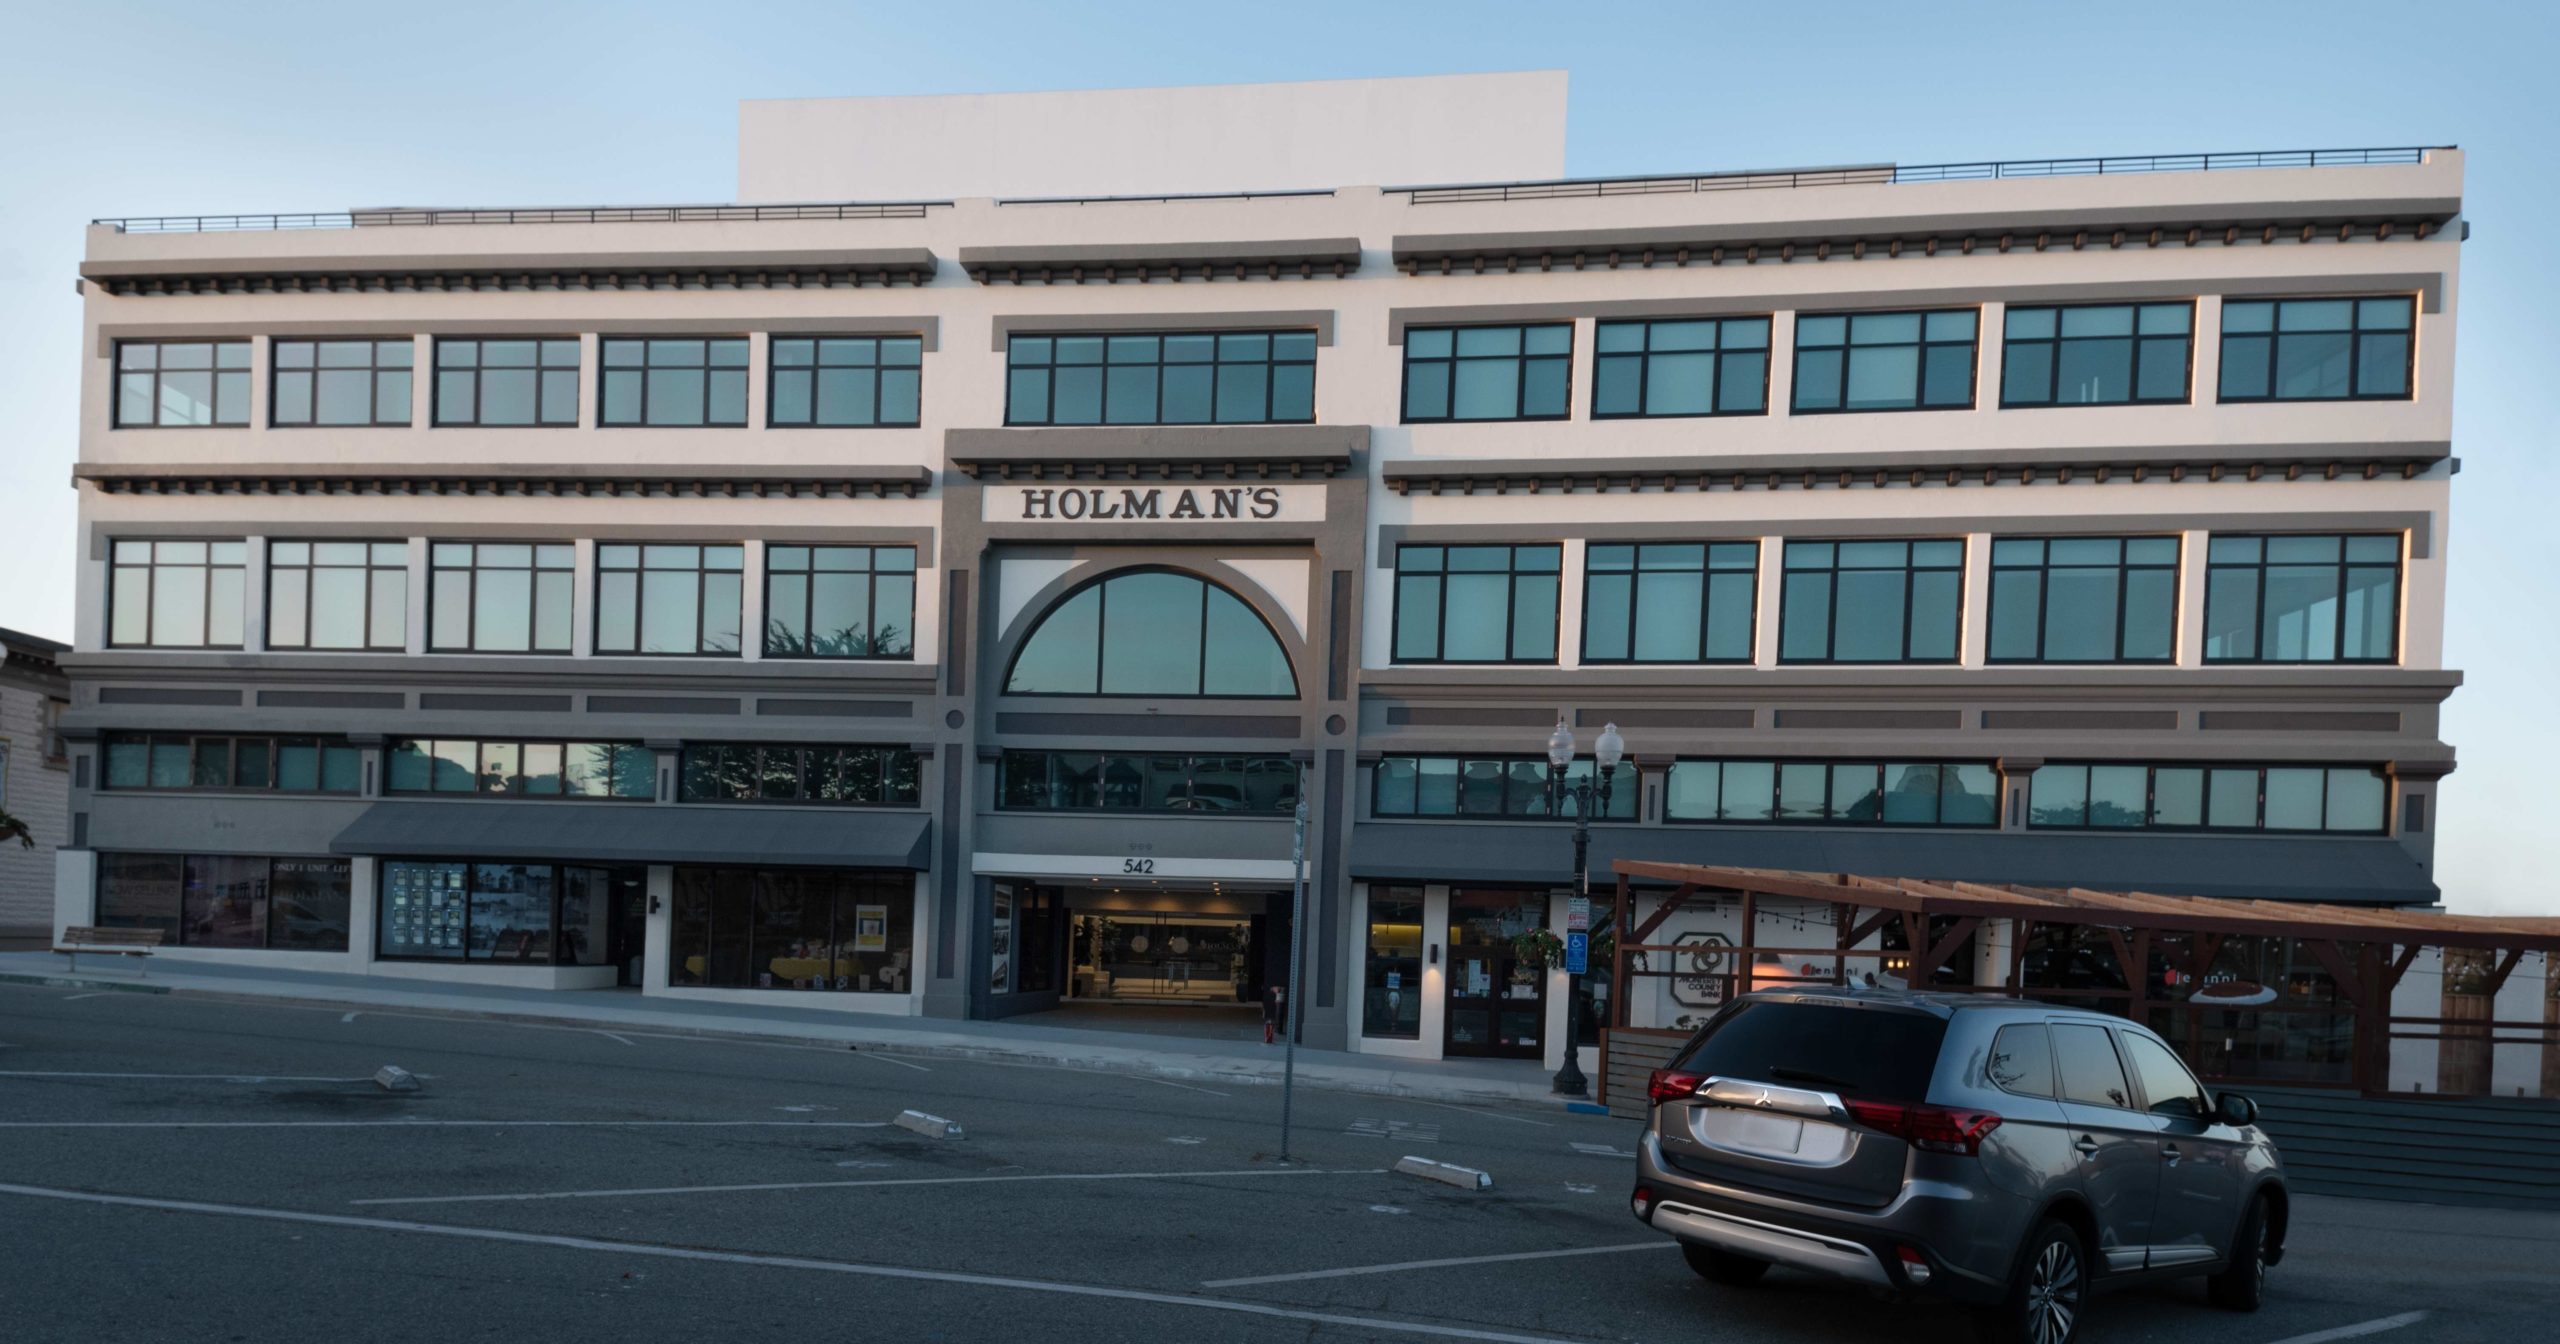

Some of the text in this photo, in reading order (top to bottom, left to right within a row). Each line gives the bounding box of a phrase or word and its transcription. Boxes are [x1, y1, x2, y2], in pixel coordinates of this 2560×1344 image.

[1021, 487, 1280, 520] HOLMAN'S
[273, 863, 296, 872] ONLY
[307, 863, 329, 873] UNIT
[1123, 858, 1154, 874] 542
[1810, 965, 1858, 976] jenini
[2176, 971, 2237, 985] jeinni
